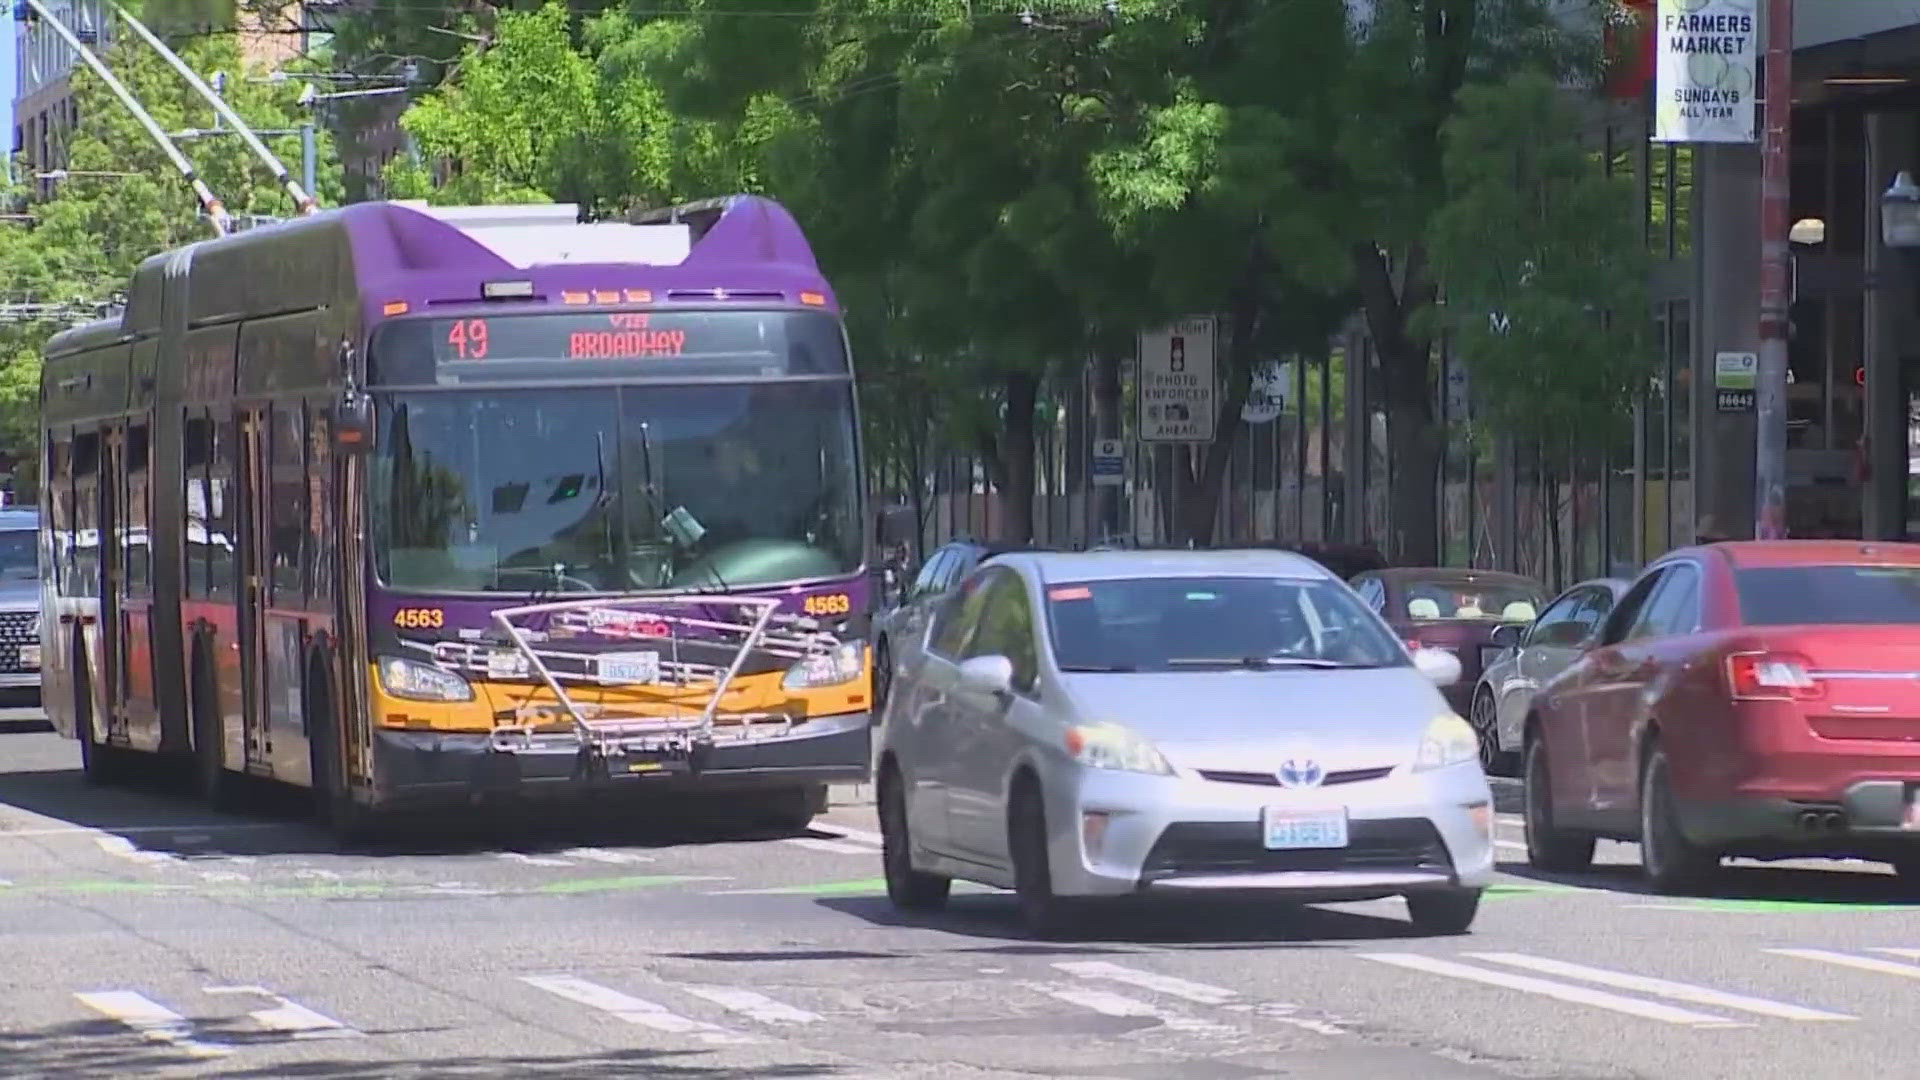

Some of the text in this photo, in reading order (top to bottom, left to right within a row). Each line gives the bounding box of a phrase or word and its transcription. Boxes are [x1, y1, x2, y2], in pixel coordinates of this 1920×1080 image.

[1665, 14, 1752, 33] FARMERS
[1670, 36, 1745, 55] MARKET
[1674, 88, 1740, 104] SUNDAYS
[1680, 107, 1733, 119] ALL YEAR
[448, 319, 685, 360] 49 BROADWAY
[1155, 375, 1198, 387] PHOTO
[1144, 387, 1210, 400] ENFORCED
[1155, 423, 1197, 436] AHEAD
[804, 594, 849, 616] 4563
[394, 608, 444, 628] 4563
